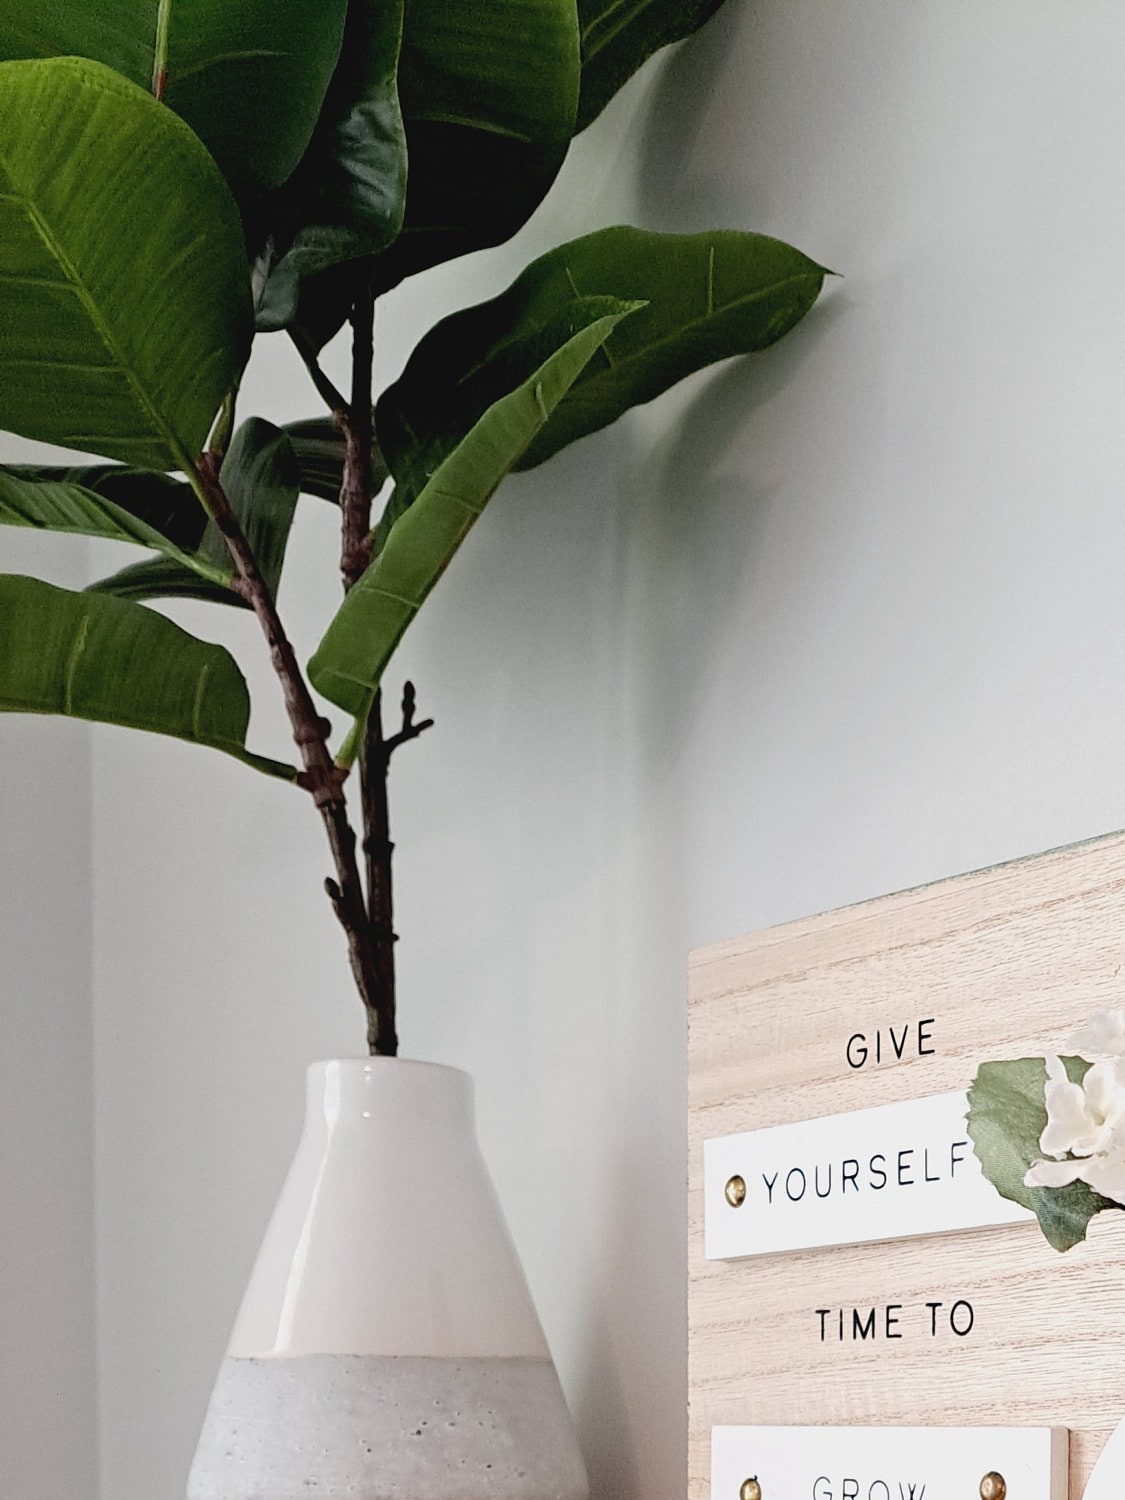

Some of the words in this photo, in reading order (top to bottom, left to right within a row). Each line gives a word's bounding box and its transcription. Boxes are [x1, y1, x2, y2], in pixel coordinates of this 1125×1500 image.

[845, 1017, 937, 1069] GIVE
[760, 1140, 969, 1205] YOURSELF
[815, 1303, 904, 1343] TIME
[925, 1299, 975, 1337] TO
